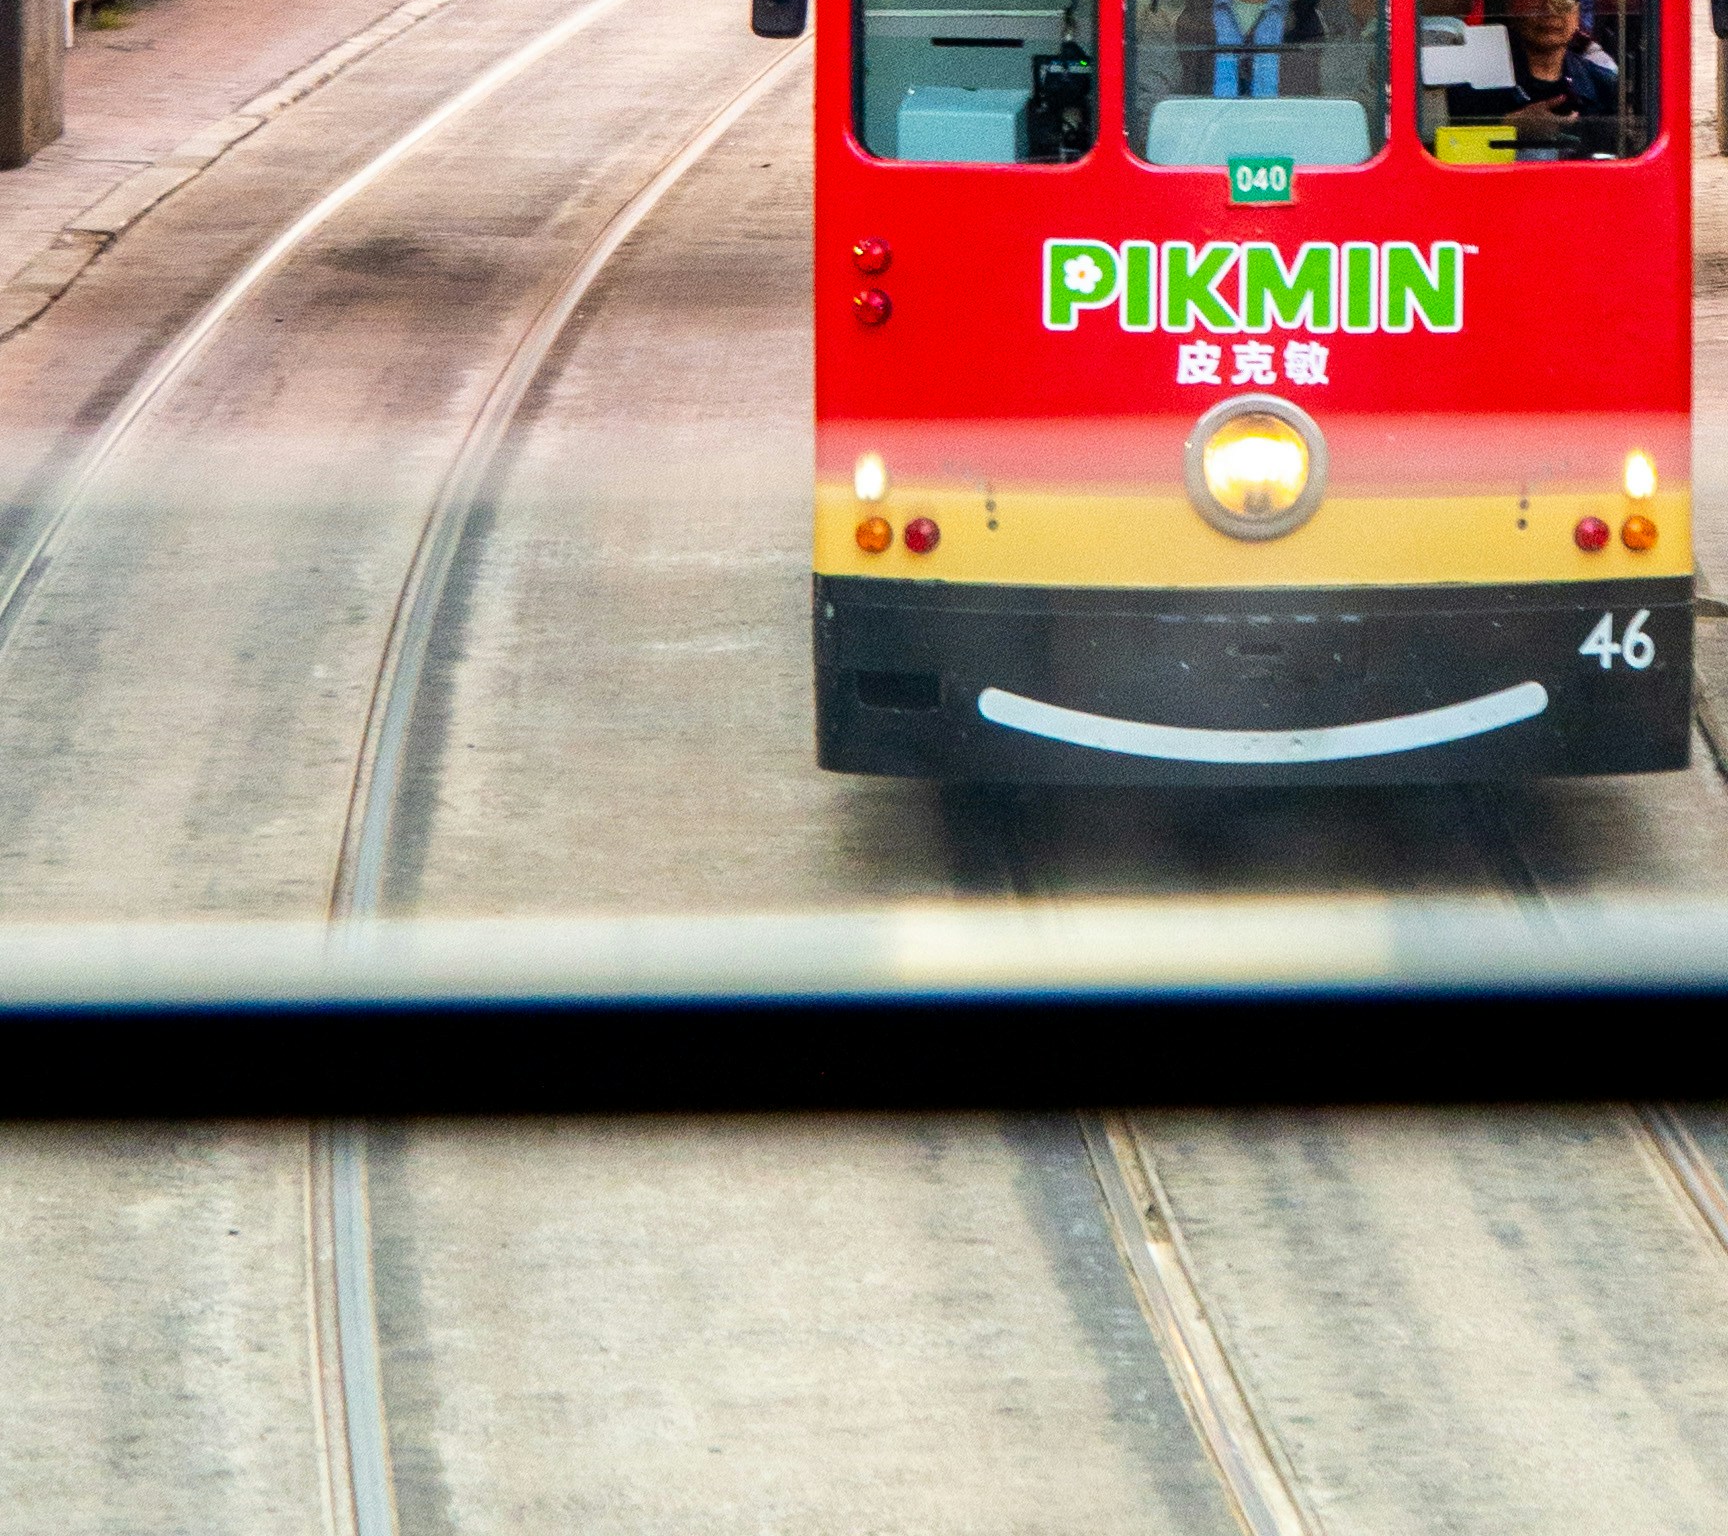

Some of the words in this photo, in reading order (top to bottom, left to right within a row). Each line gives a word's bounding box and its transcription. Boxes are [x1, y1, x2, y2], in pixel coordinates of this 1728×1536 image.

[1236, 165, 1287, 192] 040
[1042, 237, 1463, 333] PIKMIN
[1176, 339, 1330, 385] 皮克敏
[1578, 609, 1656, 669] 46
